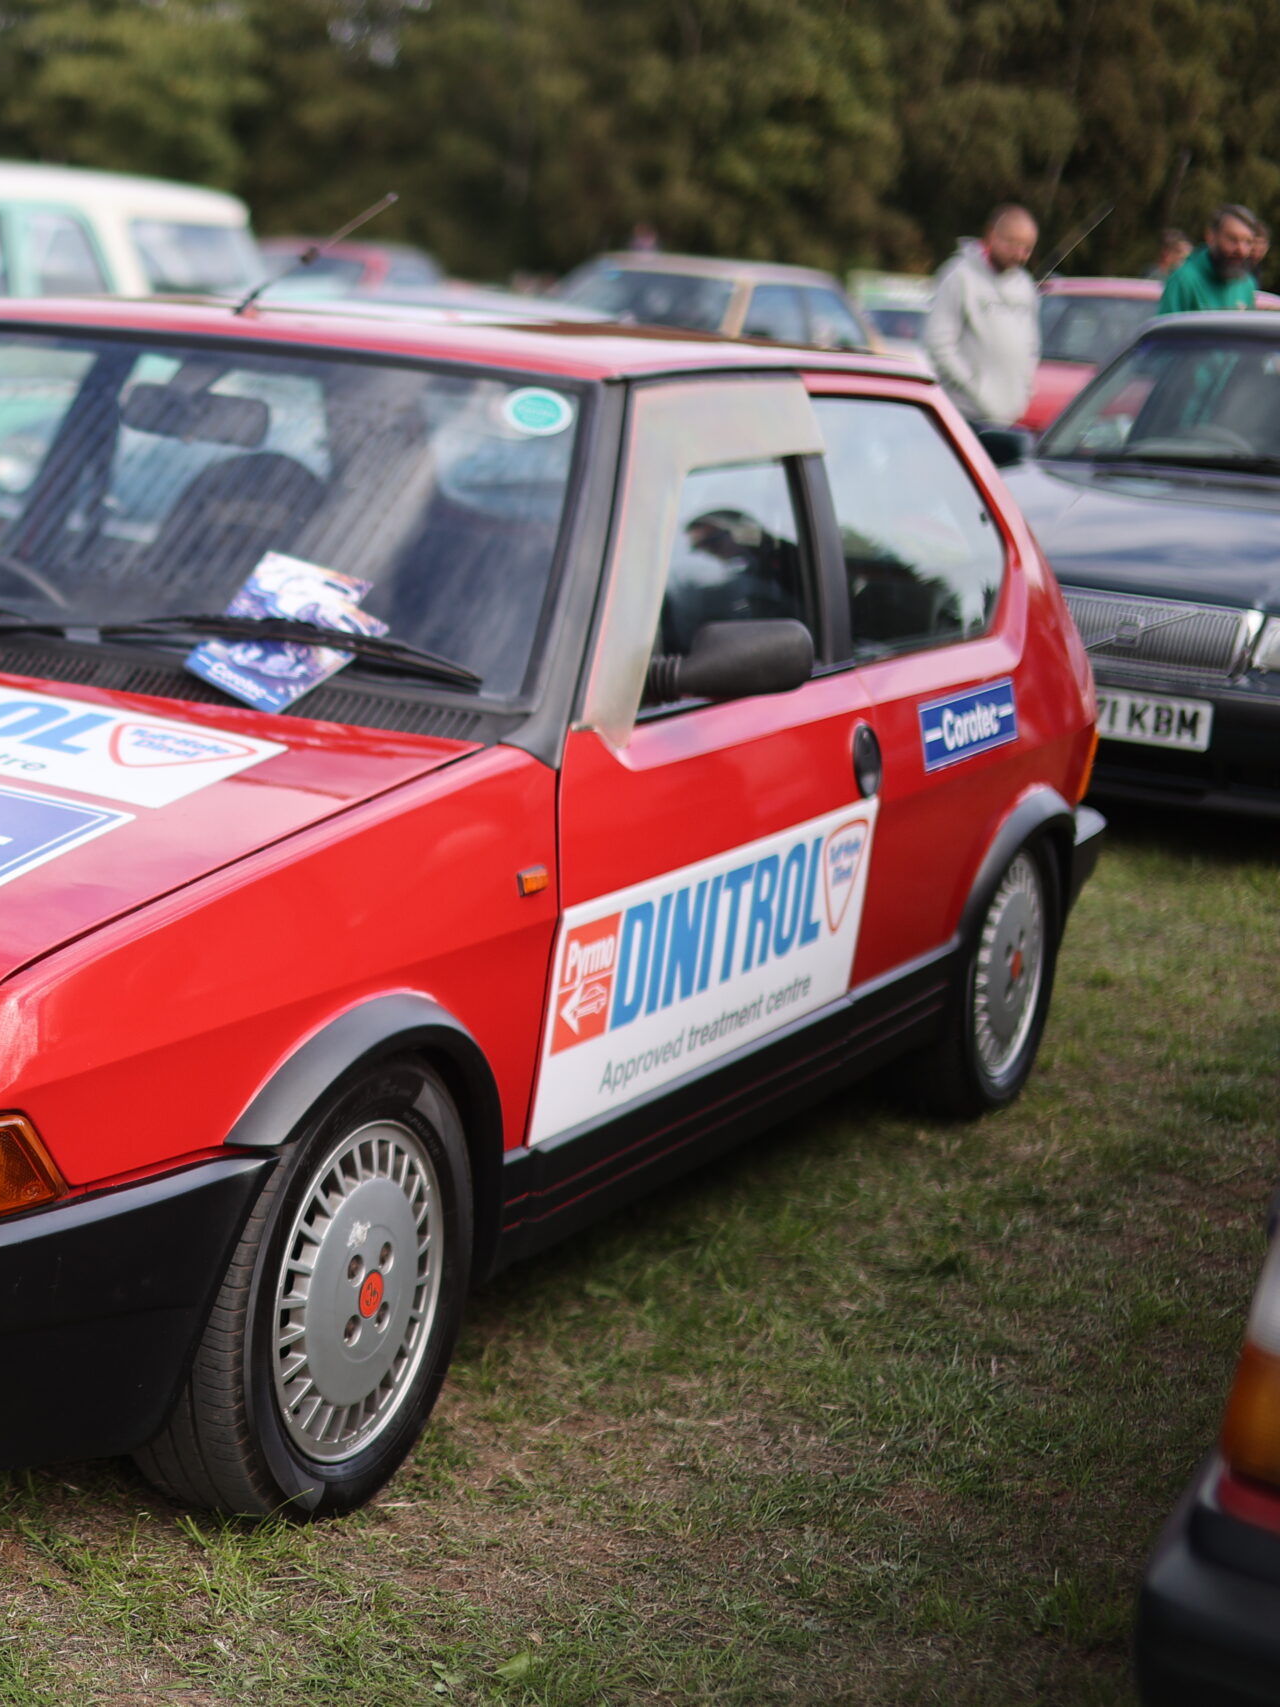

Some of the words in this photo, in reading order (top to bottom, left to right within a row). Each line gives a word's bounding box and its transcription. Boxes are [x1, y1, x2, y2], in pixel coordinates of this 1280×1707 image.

[942, 701, 1000, 751] Corotec
[1127, 702, 1200, 741] KBM
[564, 934, 615, 987] Pyrmo
[609, 836, 824, 1033] DINITROL
[598, 1030, 686, 1096] Approved
[686, 997, 764, 1052] treatment
[765, 974, 812, 1015] centre
